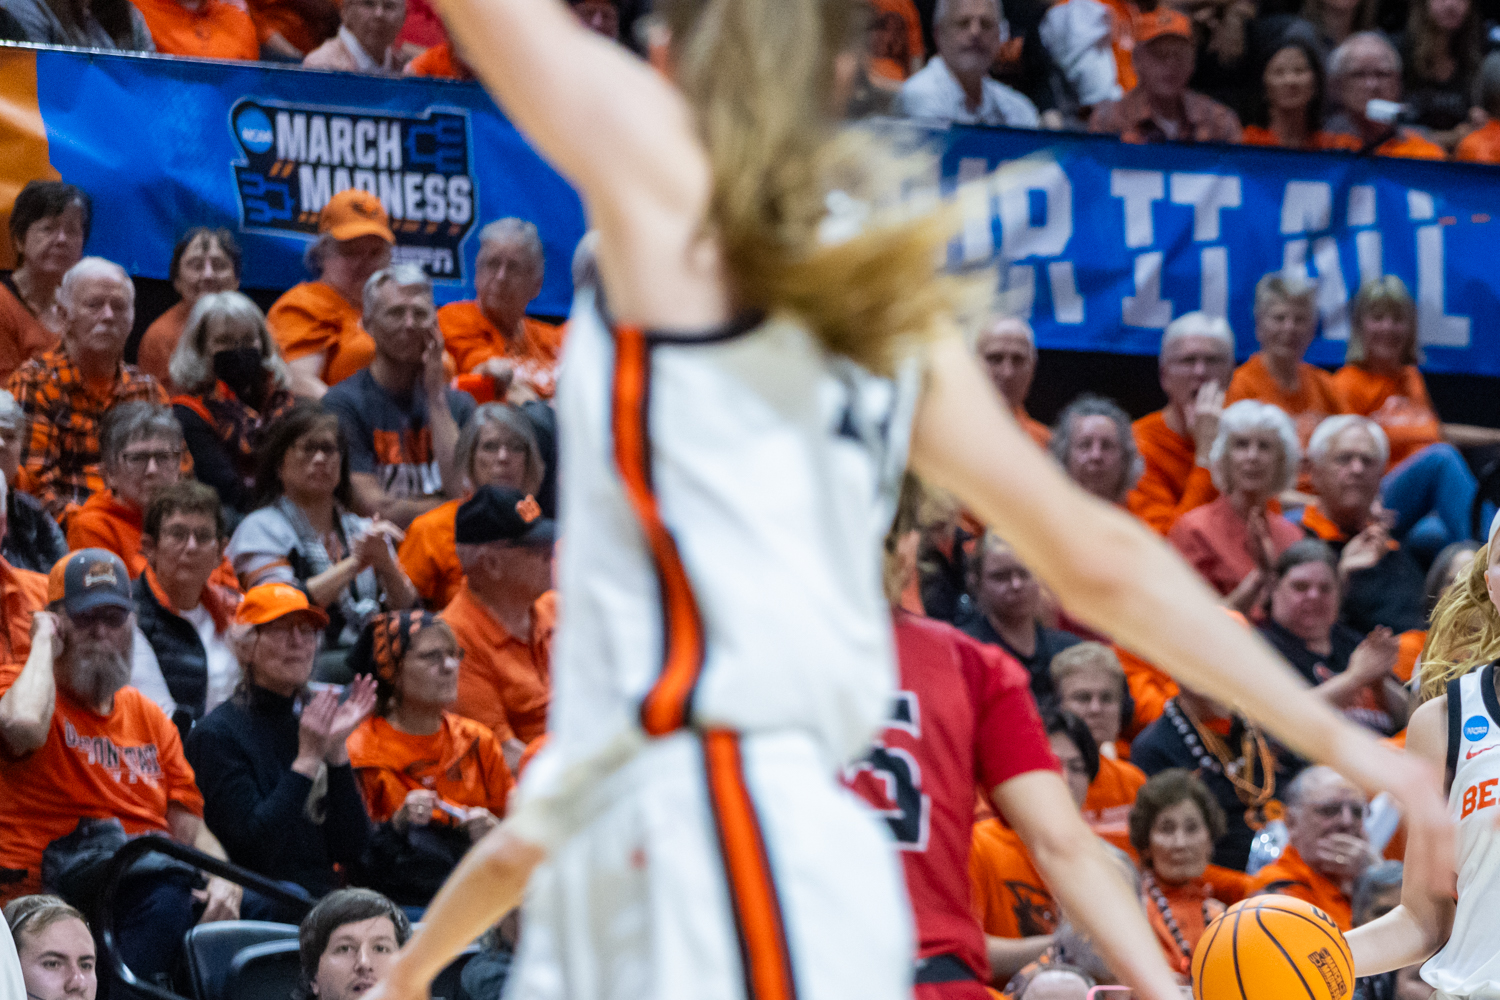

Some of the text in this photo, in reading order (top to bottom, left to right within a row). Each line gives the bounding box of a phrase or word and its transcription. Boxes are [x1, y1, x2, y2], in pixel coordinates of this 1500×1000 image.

[274, 109, 403, 171] MARCH
[1110, 169, 1242, 330] IT
[1280, 180, 1472, 348] ALL
[1466, 726, 1488, 735] NCAA
